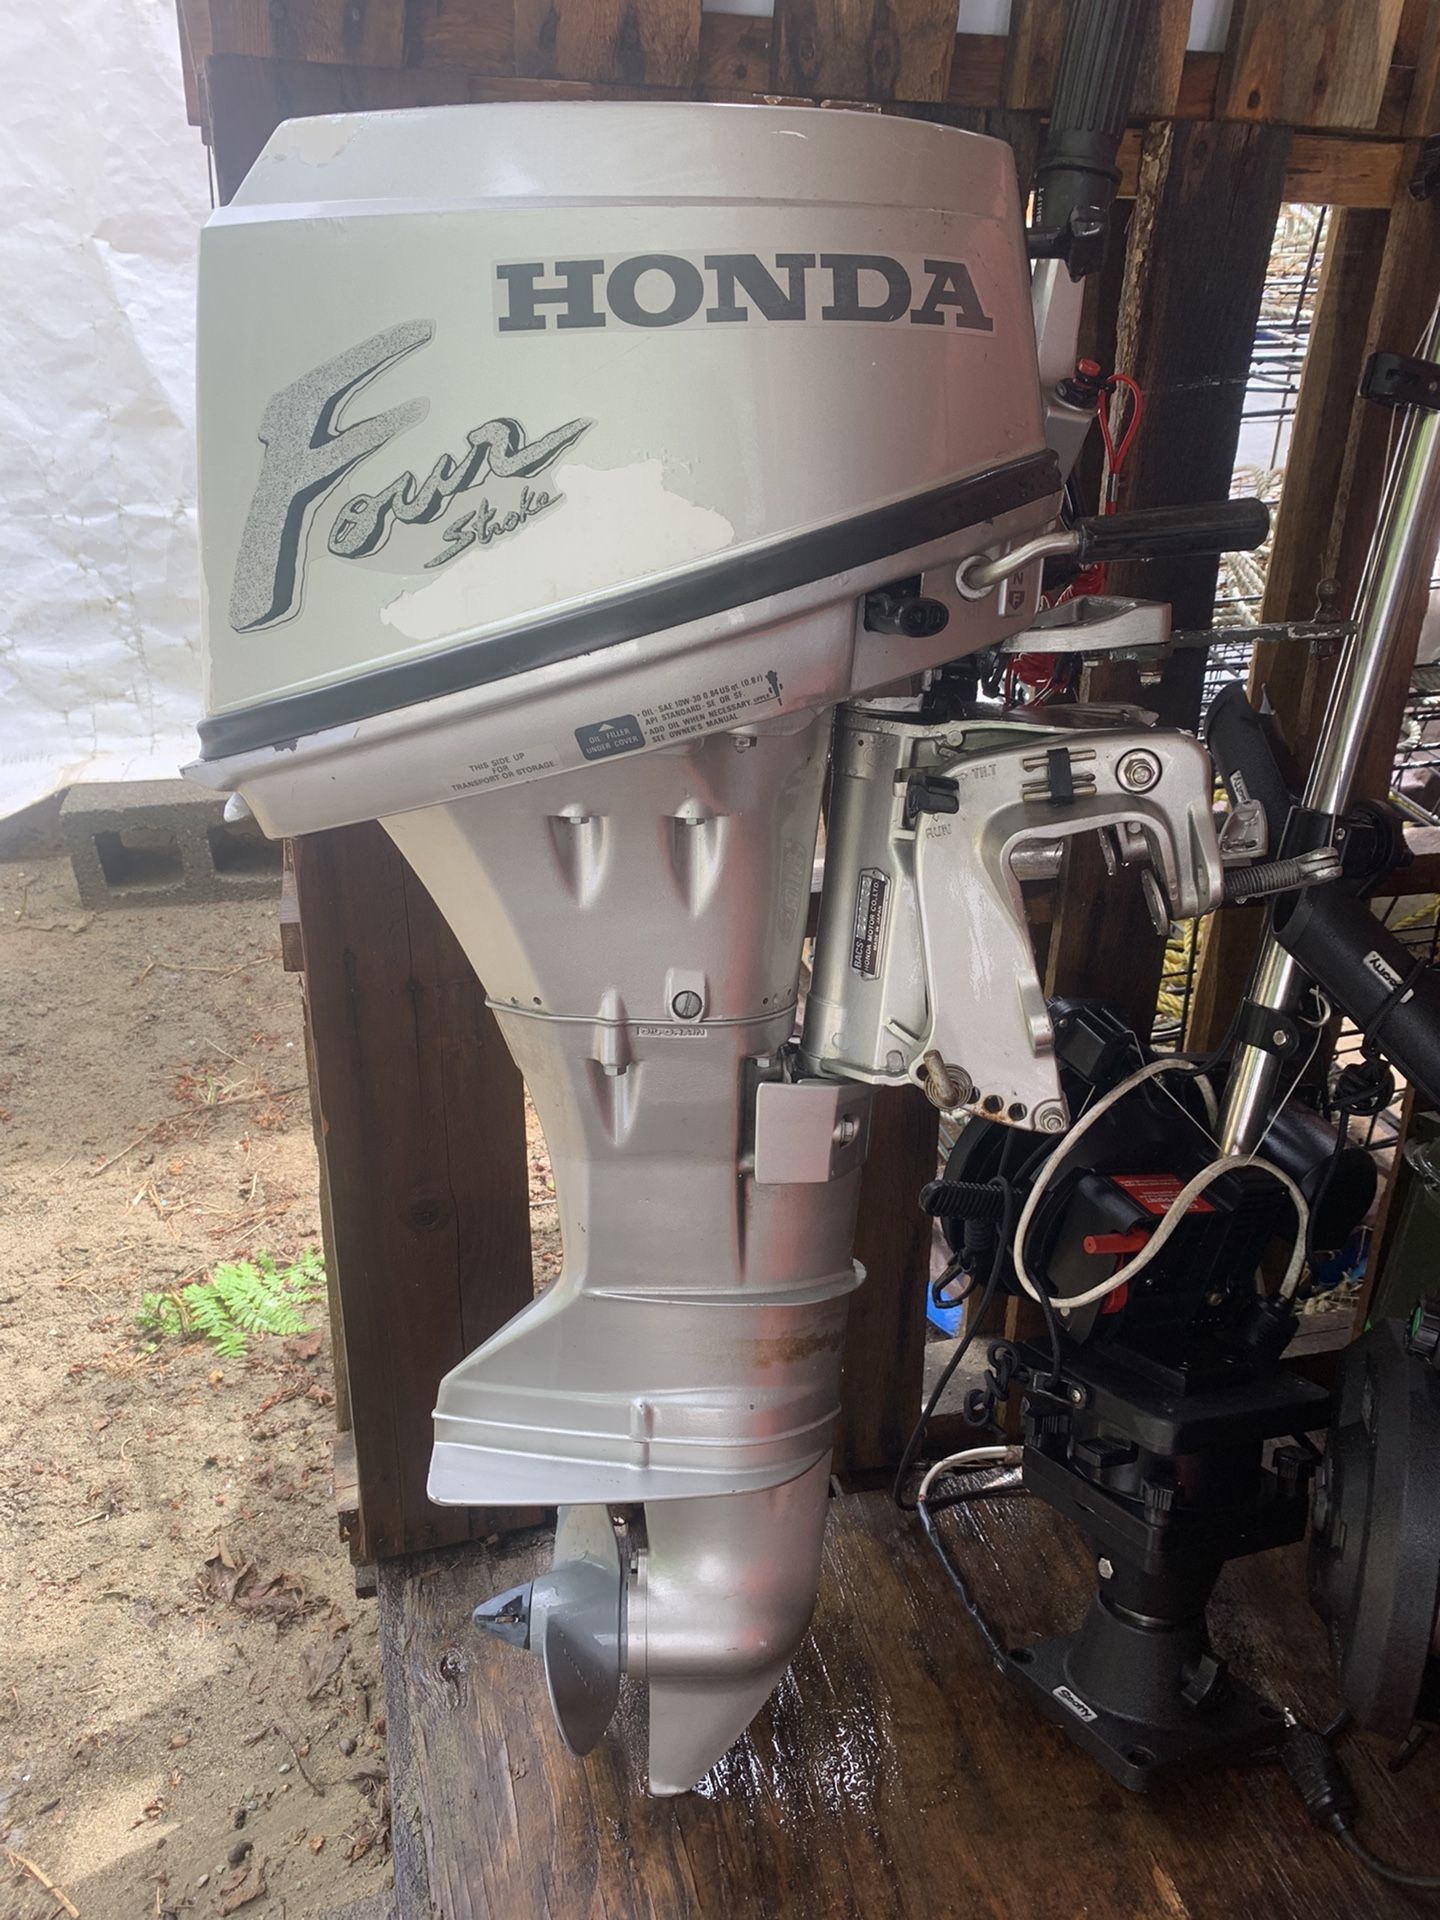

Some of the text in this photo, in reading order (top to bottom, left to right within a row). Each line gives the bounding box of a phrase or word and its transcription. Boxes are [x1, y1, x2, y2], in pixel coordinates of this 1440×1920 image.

[497, 253, 993, 332] HONDA
[228, 318, 594, 633] Four
[424, 486, 564, 569] Stroke
[1013, 572, 1024, 585] N
[641, 708, 654, 718] OIL
[658, 702, 673, 713] SAE
[719, 685, 731, 695] US
[645, 716, 659, 726] API
[661, 704, 702, 721] STANDARD
[706, 699, 716, 708] SE
[720, 694, 731, 704] OR
[588, 727, 631, 744] OIL FILLER
[649, 725, 665, 736] ADD
[667, 721, 680, 730] OIL
[682, 713, 706, 726] WHEN
[651, 734, 666, 744] SEE
[668, 723, 703, 738] OWNER'S
[586, 735, 639, 755] UNDER COVER
[468, 752, 526, 773] THIS SIDE UP
[491, 765, 510, 775] FOR
[971, 763, 997, 780] TILT
[451, 760, 555, 792] TRANSPORT OR STORAGE
[925, 823, 952, 840] RUN
[867, 913, 876, 943] MOTOR
[863, 944, 872, 972] HONDA
[663, 1027, 706, 1037] DRAIN
[1057, 1689, 1093, 1718] Scotty
